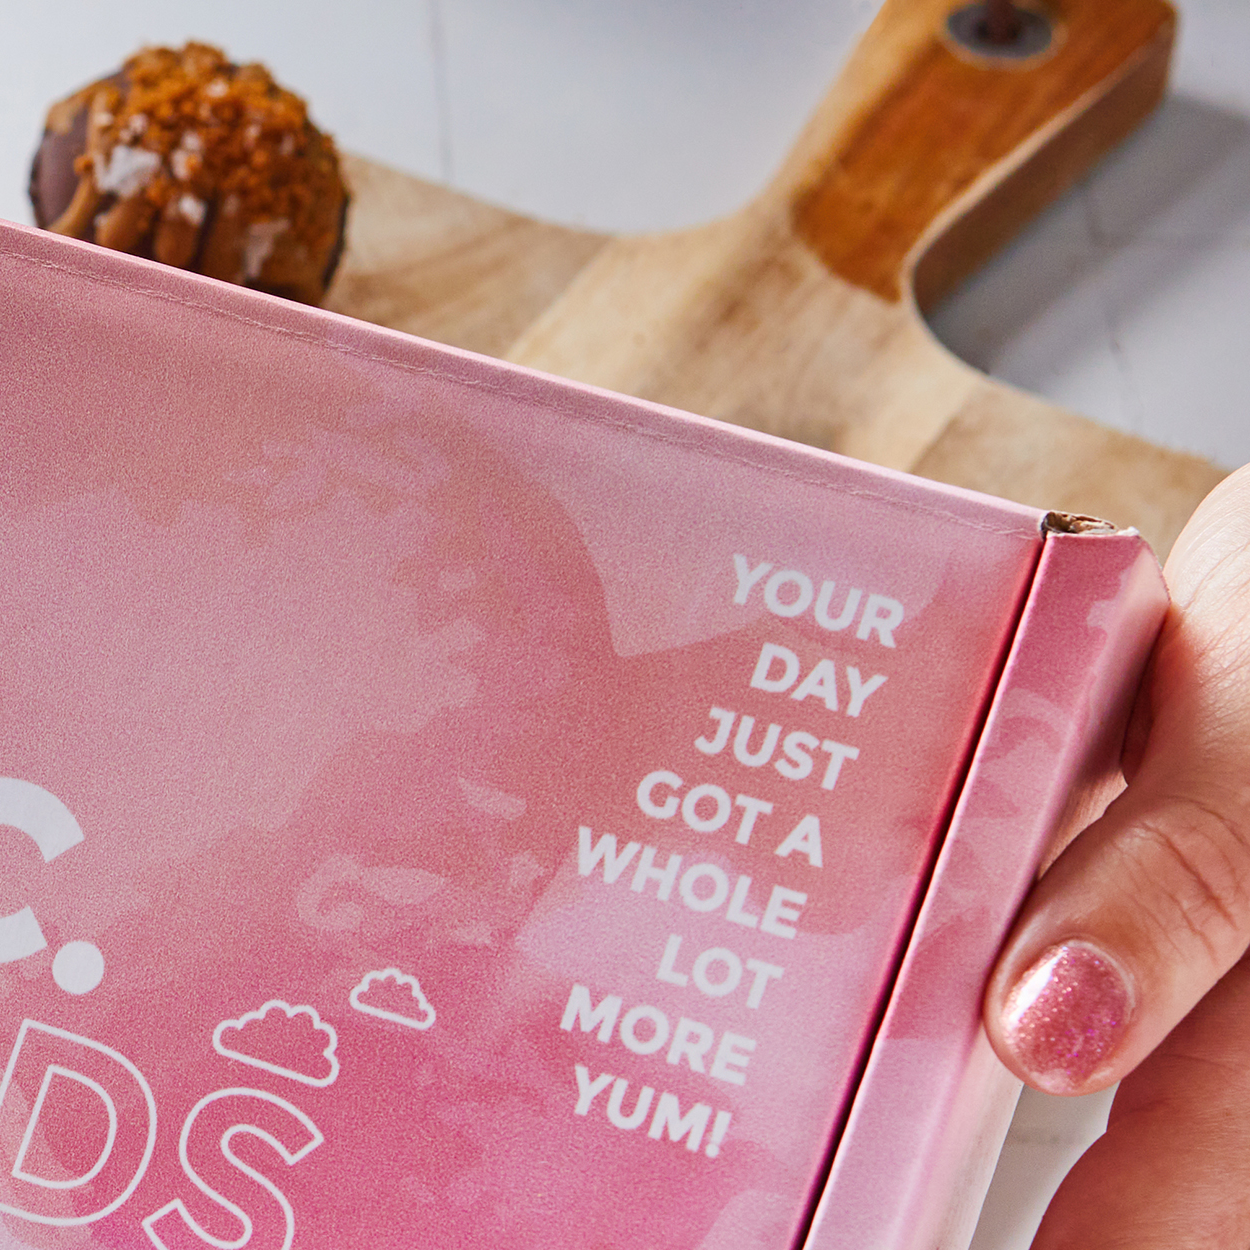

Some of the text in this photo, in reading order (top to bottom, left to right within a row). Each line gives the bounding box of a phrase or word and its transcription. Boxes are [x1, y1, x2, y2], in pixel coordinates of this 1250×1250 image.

[732, 554, 905, 648] YOUR
[750, 643, 888, 718] DAY
[694, 707, 859, 790] JUST
[637, 771, 824, 868] GOT A
[577, 826, 808, 939] WHOLE
[656, 934, 784, 1010] LOT
[560, 985, 757, 1086] MORE
[573, 1064, 732, 1158] YUM!
